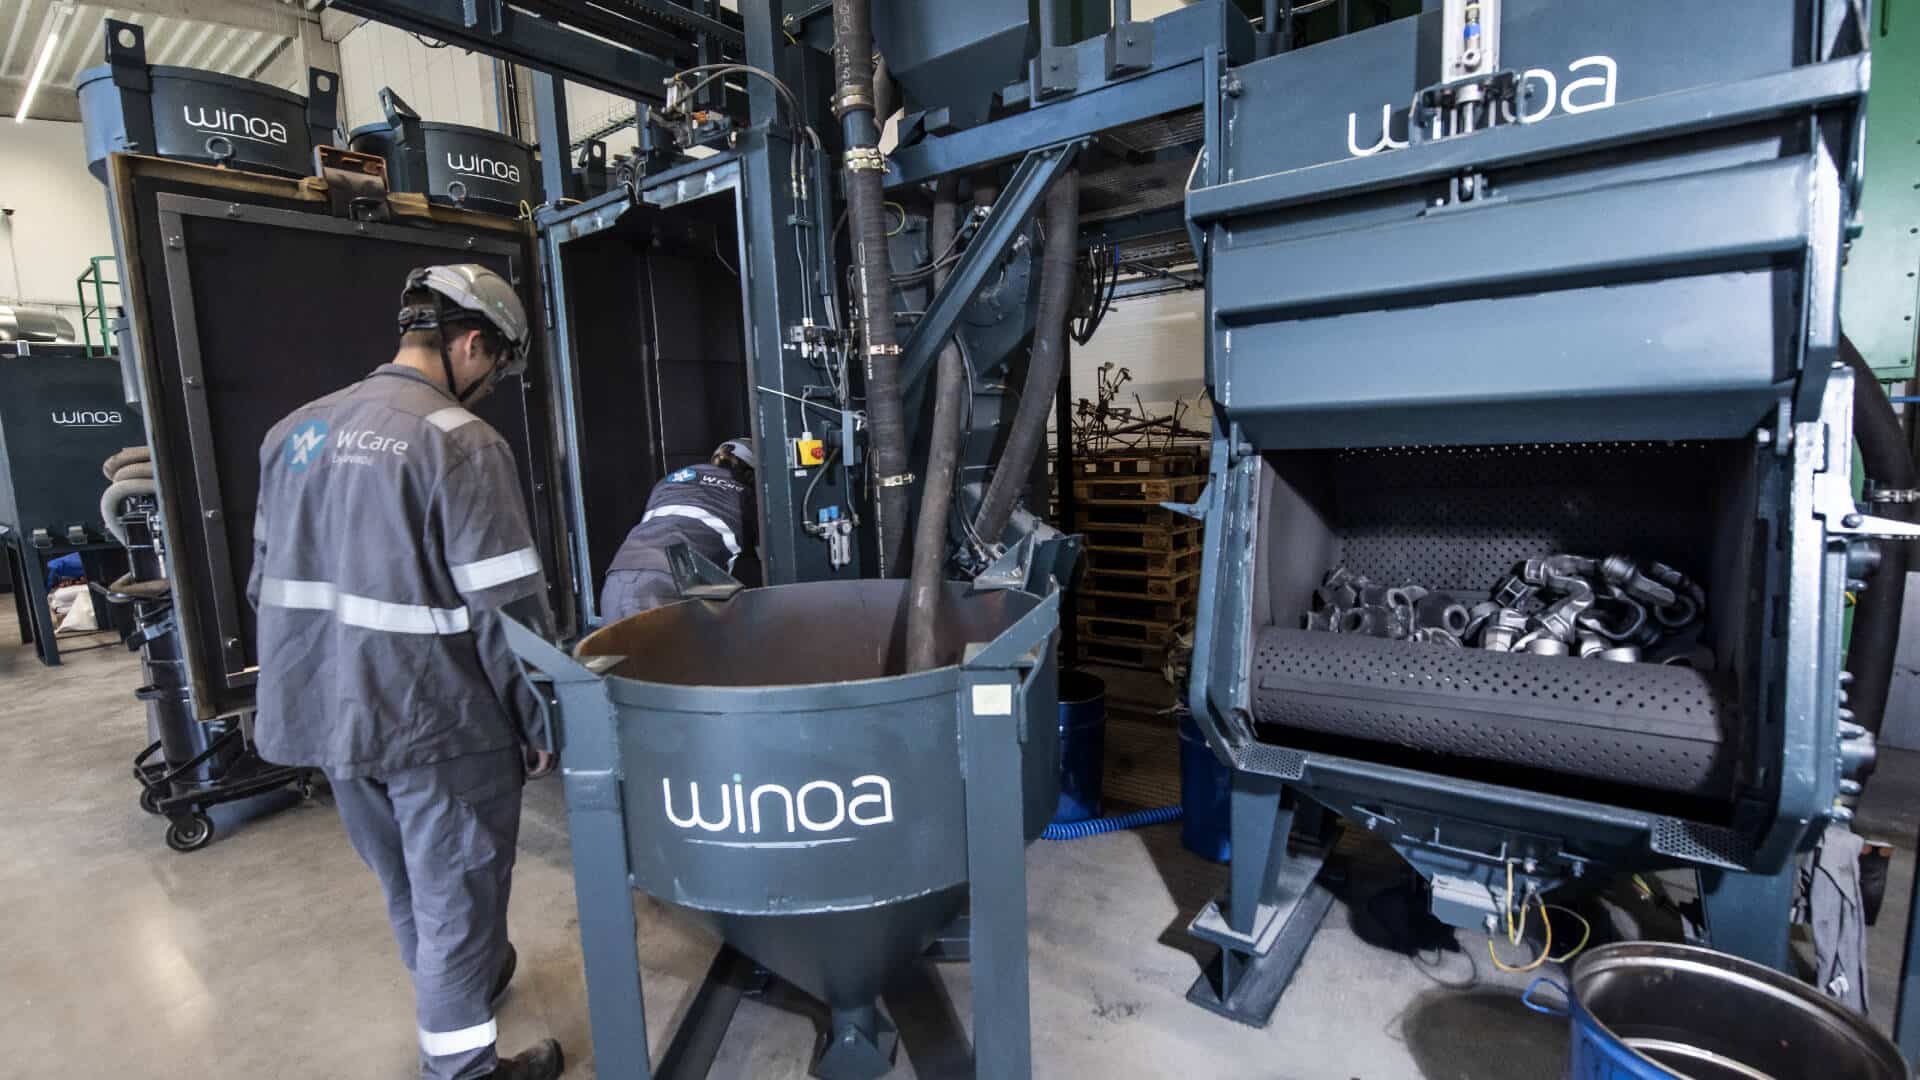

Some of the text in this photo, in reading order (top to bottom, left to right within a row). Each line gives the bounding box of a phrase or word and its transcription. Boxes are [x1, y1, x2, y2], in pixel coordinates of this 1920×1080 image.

[183, 105, 288, 144] winoa
[1348, 55, 1617, 157] woa
[447, 152, 520, 183] winoa
[51, 410, 122, 424] winoa
[662, 773, 894, 834] winoa
